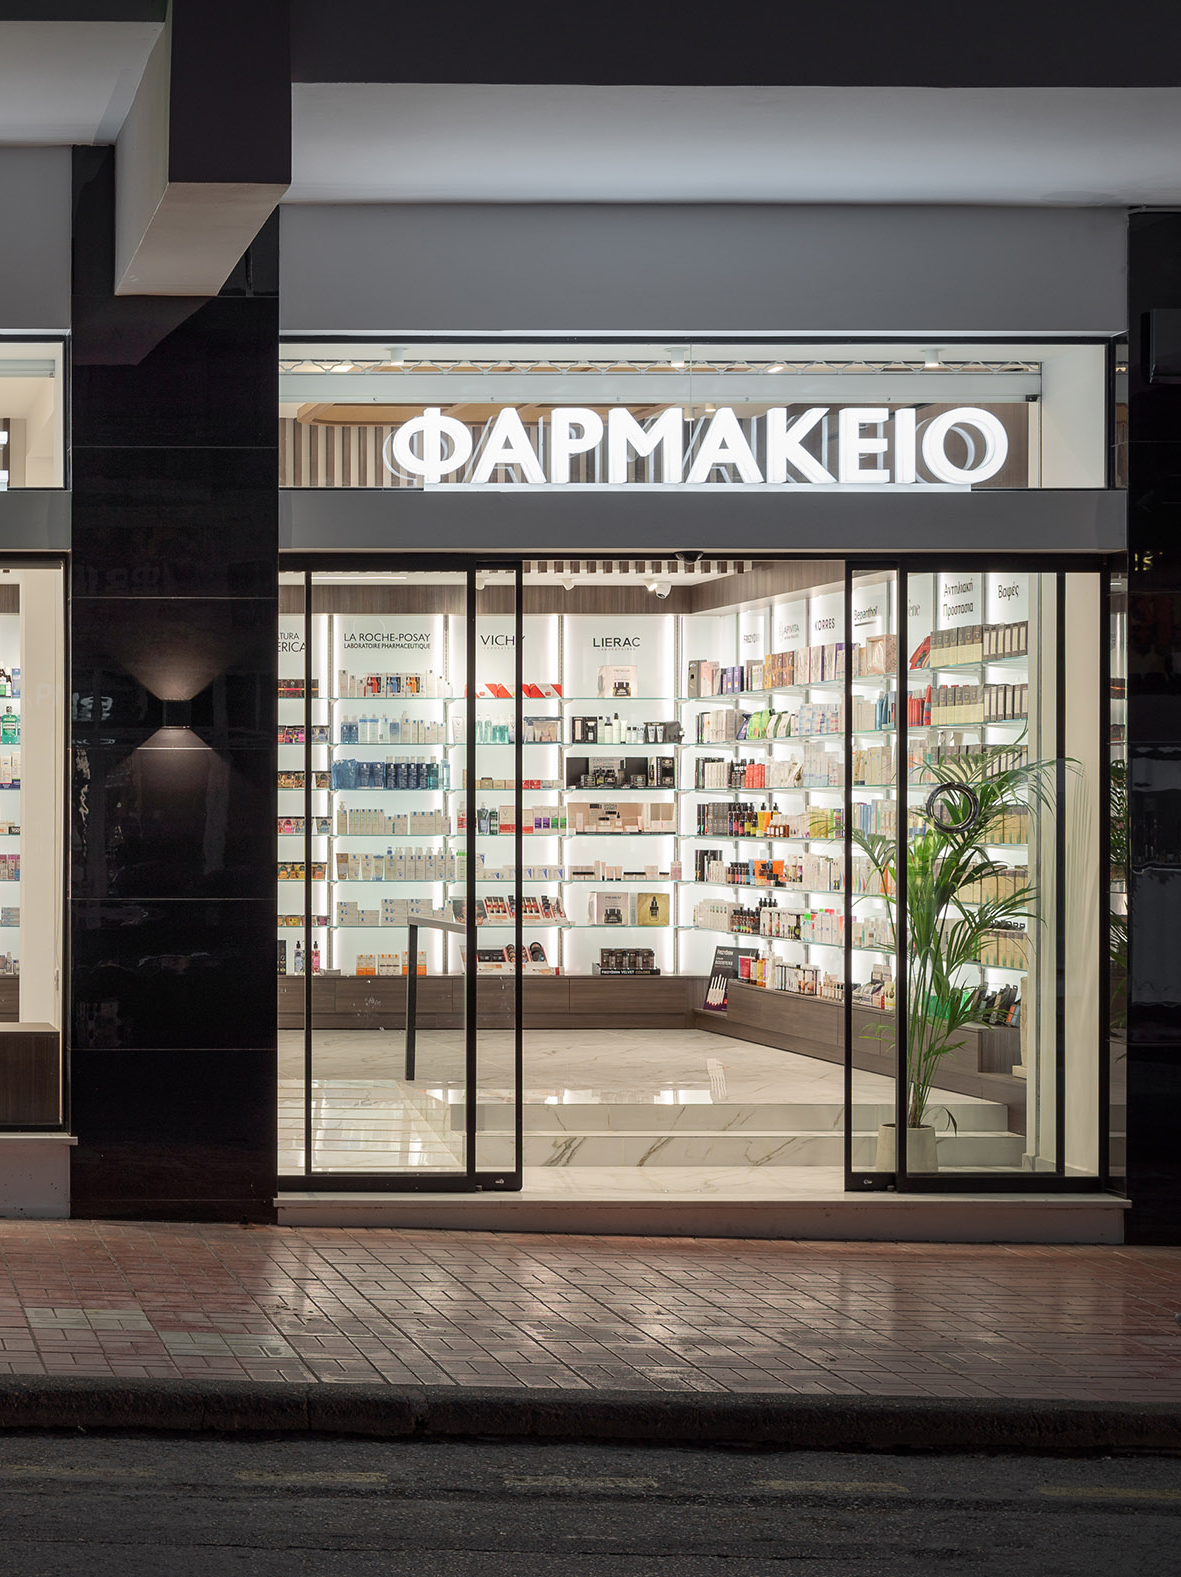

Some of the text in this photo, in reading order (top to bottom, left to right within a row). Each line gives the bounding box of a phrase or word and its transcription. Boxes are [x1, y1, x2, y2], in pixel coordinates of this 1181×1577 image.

[391, 406, 1009, 484] ΦΑΡΜΑΚΕΙΟ
[997, 582, 1019, 600] Βαφές
[814, 617, 836, 631] KORRES
[343, 632, 431, 642] LA ROCHE-POSAY
[480, 634, 526, 646] VICH
[593, 637, 641, 648] LIERAC
[381, 642, 431, 650] PHARMACEUTIQUE
